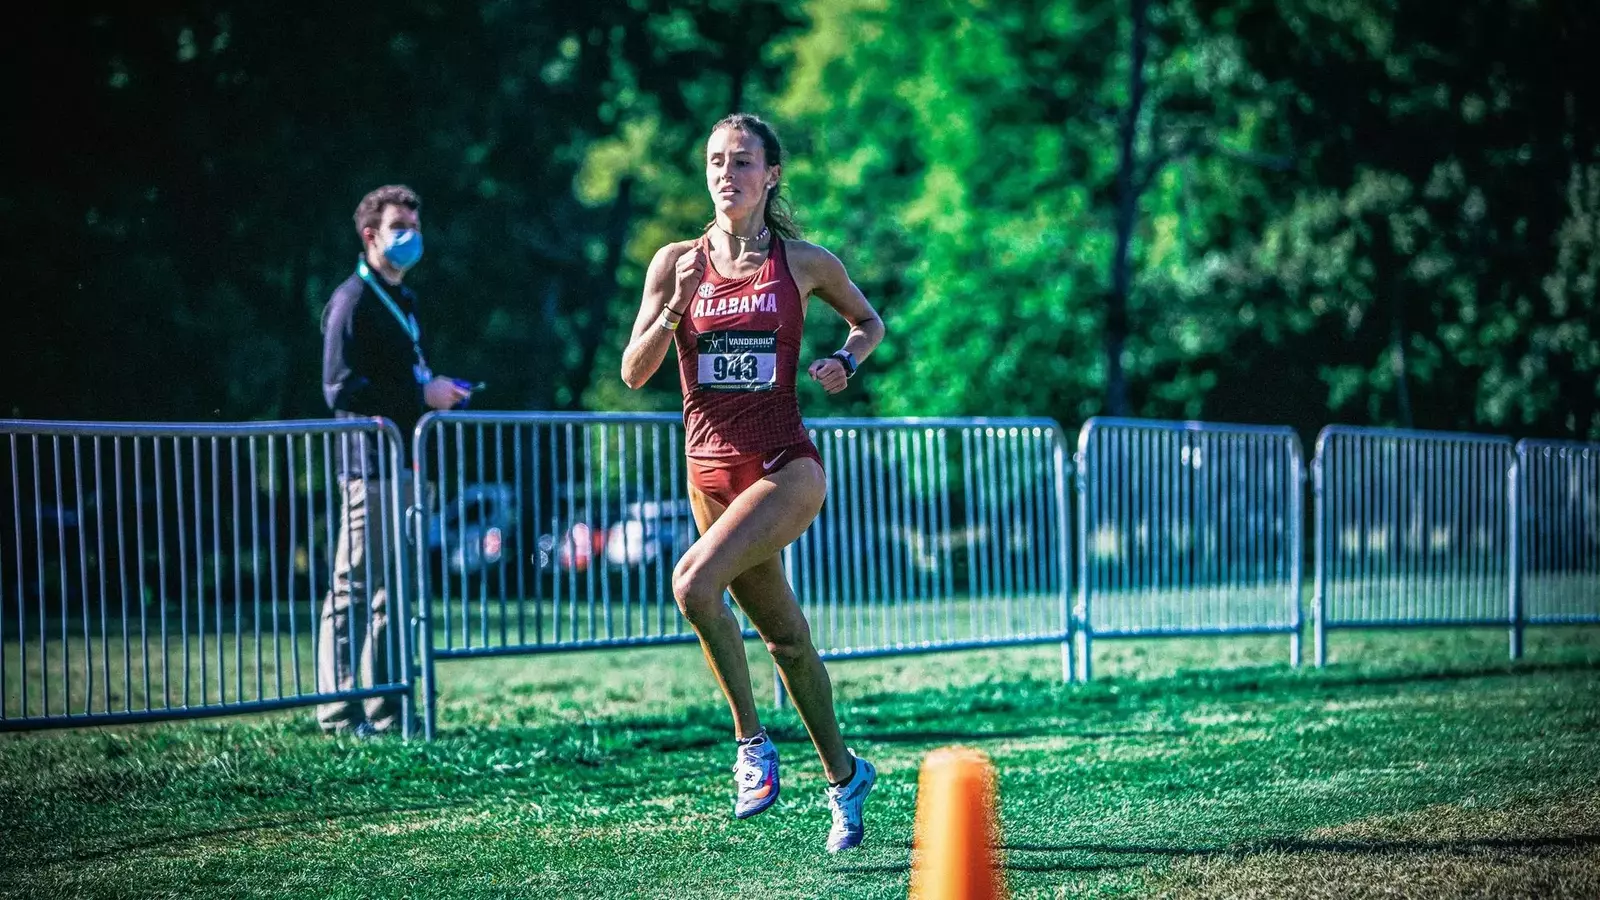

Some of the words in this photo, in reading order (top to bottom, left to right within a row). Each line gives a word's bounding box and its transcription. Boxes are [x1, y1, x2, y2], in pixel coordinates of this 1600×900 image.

[693, 293, 777, 318] ALABAMA
[728, 337, 775, 346] VANDERBILT
[713, 355, 758, 381] 943
